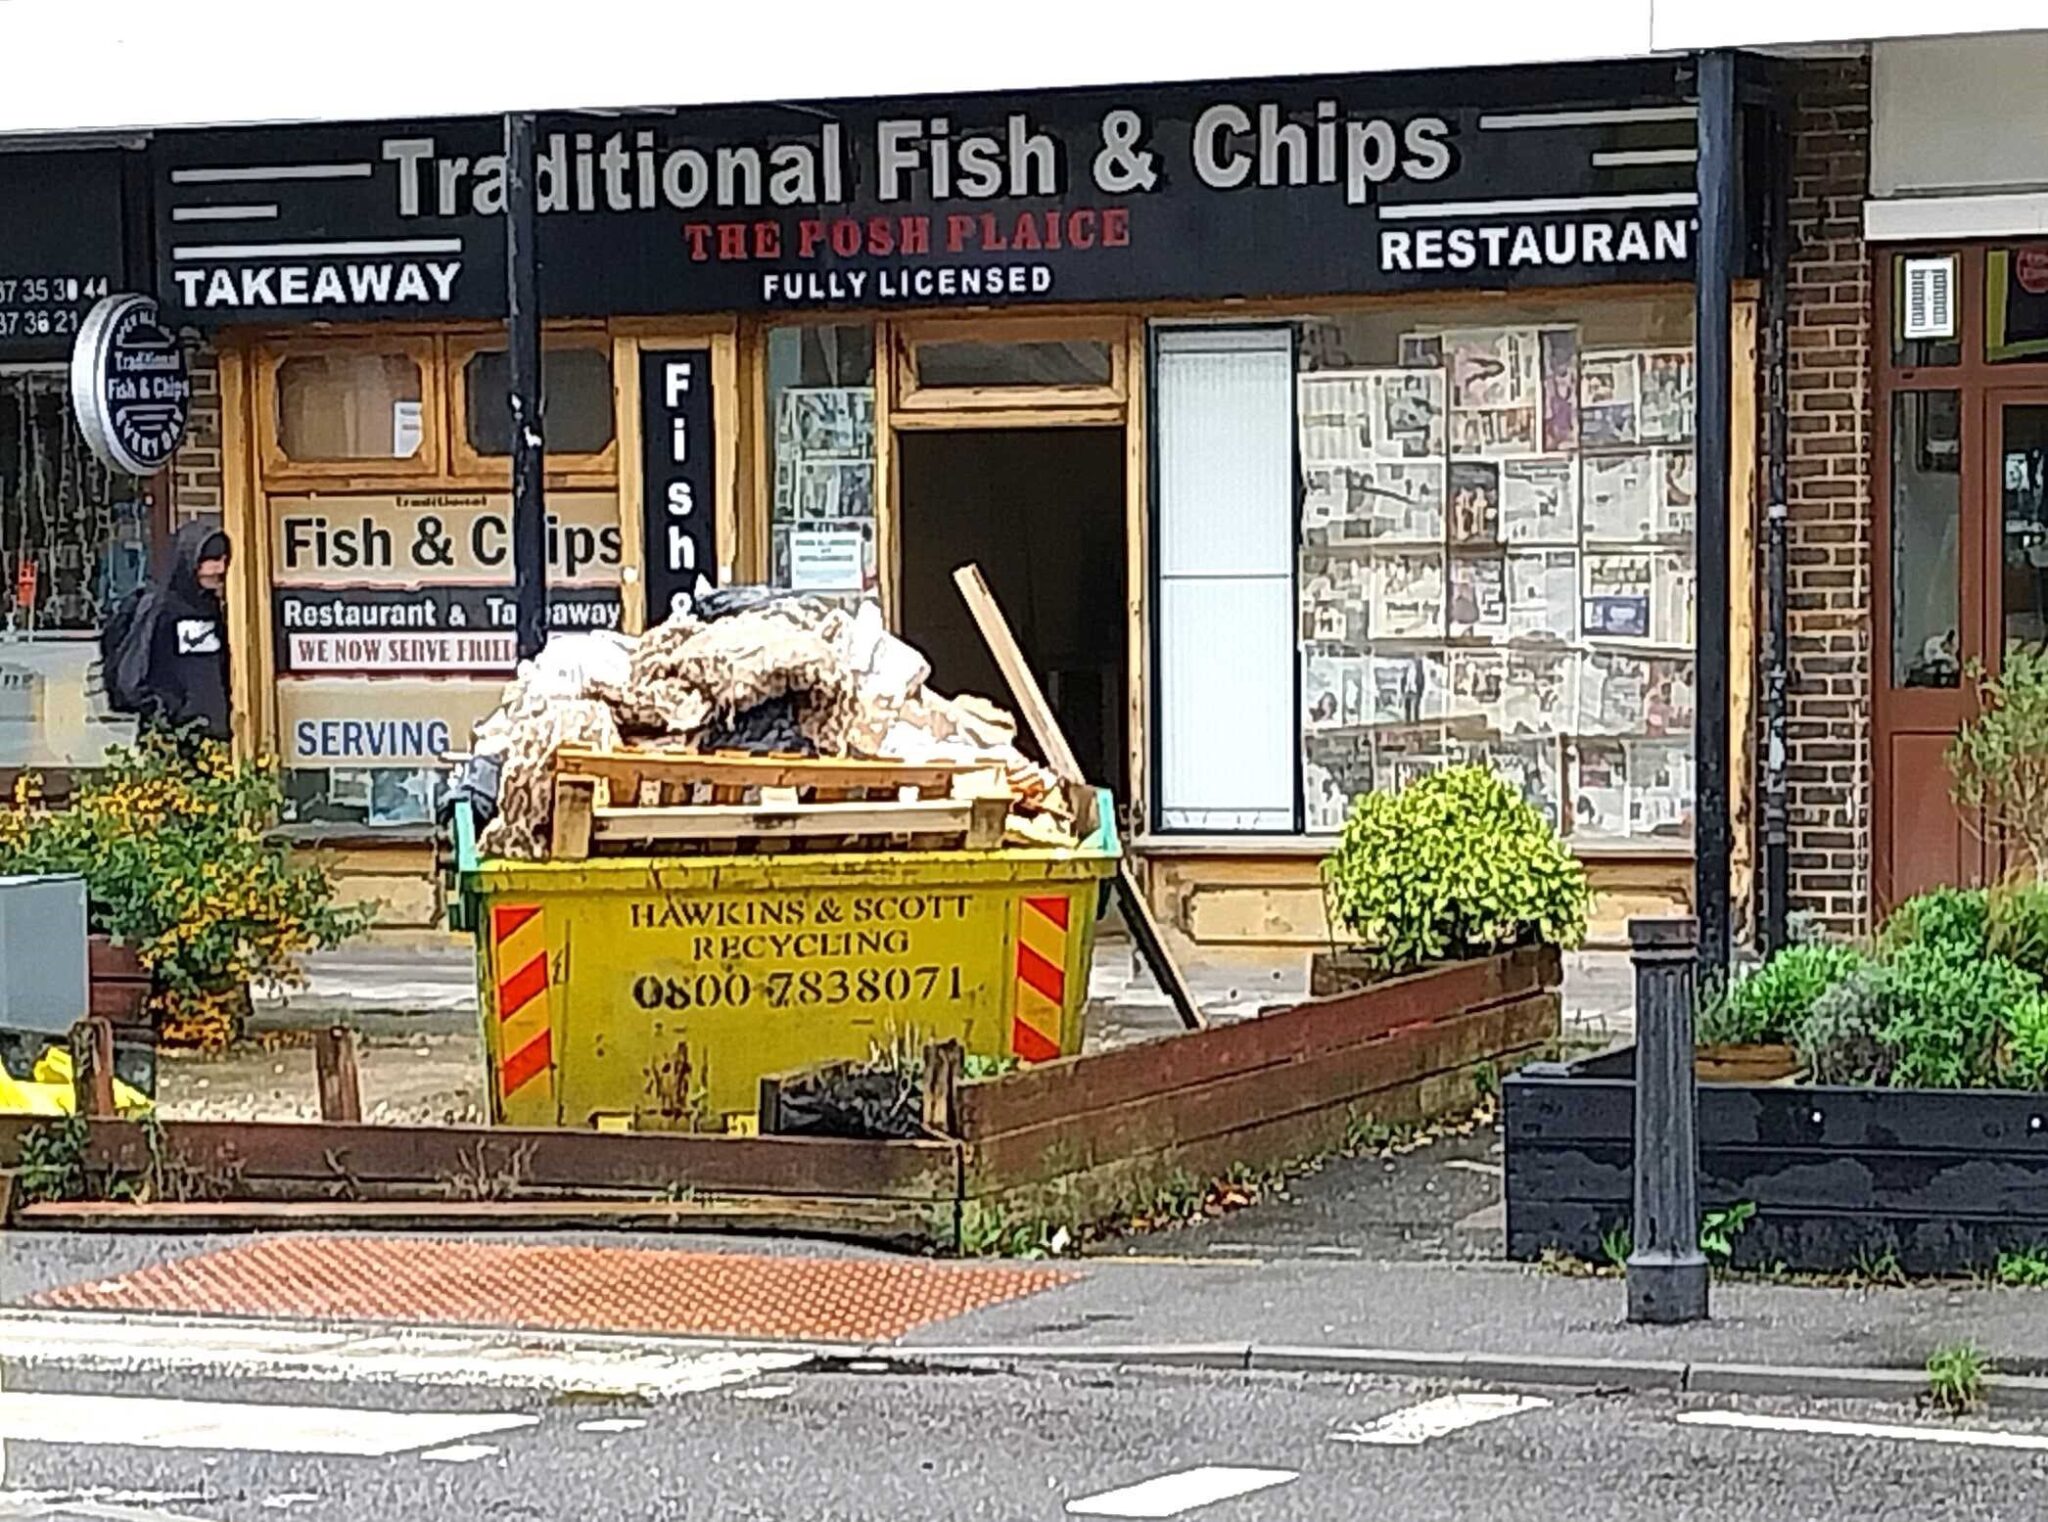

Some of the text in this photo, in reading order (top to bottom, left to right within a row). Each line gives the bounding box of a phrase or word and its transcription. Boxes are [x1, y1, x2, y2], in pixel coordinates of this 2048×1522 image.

[382, 101, 1452, 217] Traditional Fish & Chips
[684, 208, 1131, 261] THE POSH PLAICE
[1380, 219, 1699, 271] RESTAURAN
[174, 262, 461, 308] TAKEAWAY
[763, 266, 1052, 300] FULLY LICENSED
[108, 376, 137, 400] Fish
[153, 375, 190, 402] Chips
[665, 362, 697, 570] Fish
[284, 515, 622, 577] Fish & Cips
[284, 598, 620, 629] Restaurant & Taaway
[298, 639, 329, 662] WE
[334, 639, 382, 662] NOW
[388, 638, 450, 662] SERVE
[297, 720, 450, 757] SERVING
[630, 894, 974, 929] HAWKINS & SCOTT
[693, 930, 910, 961] RECYCLING
[632, 965, 964, 1011] 0800 7838071
